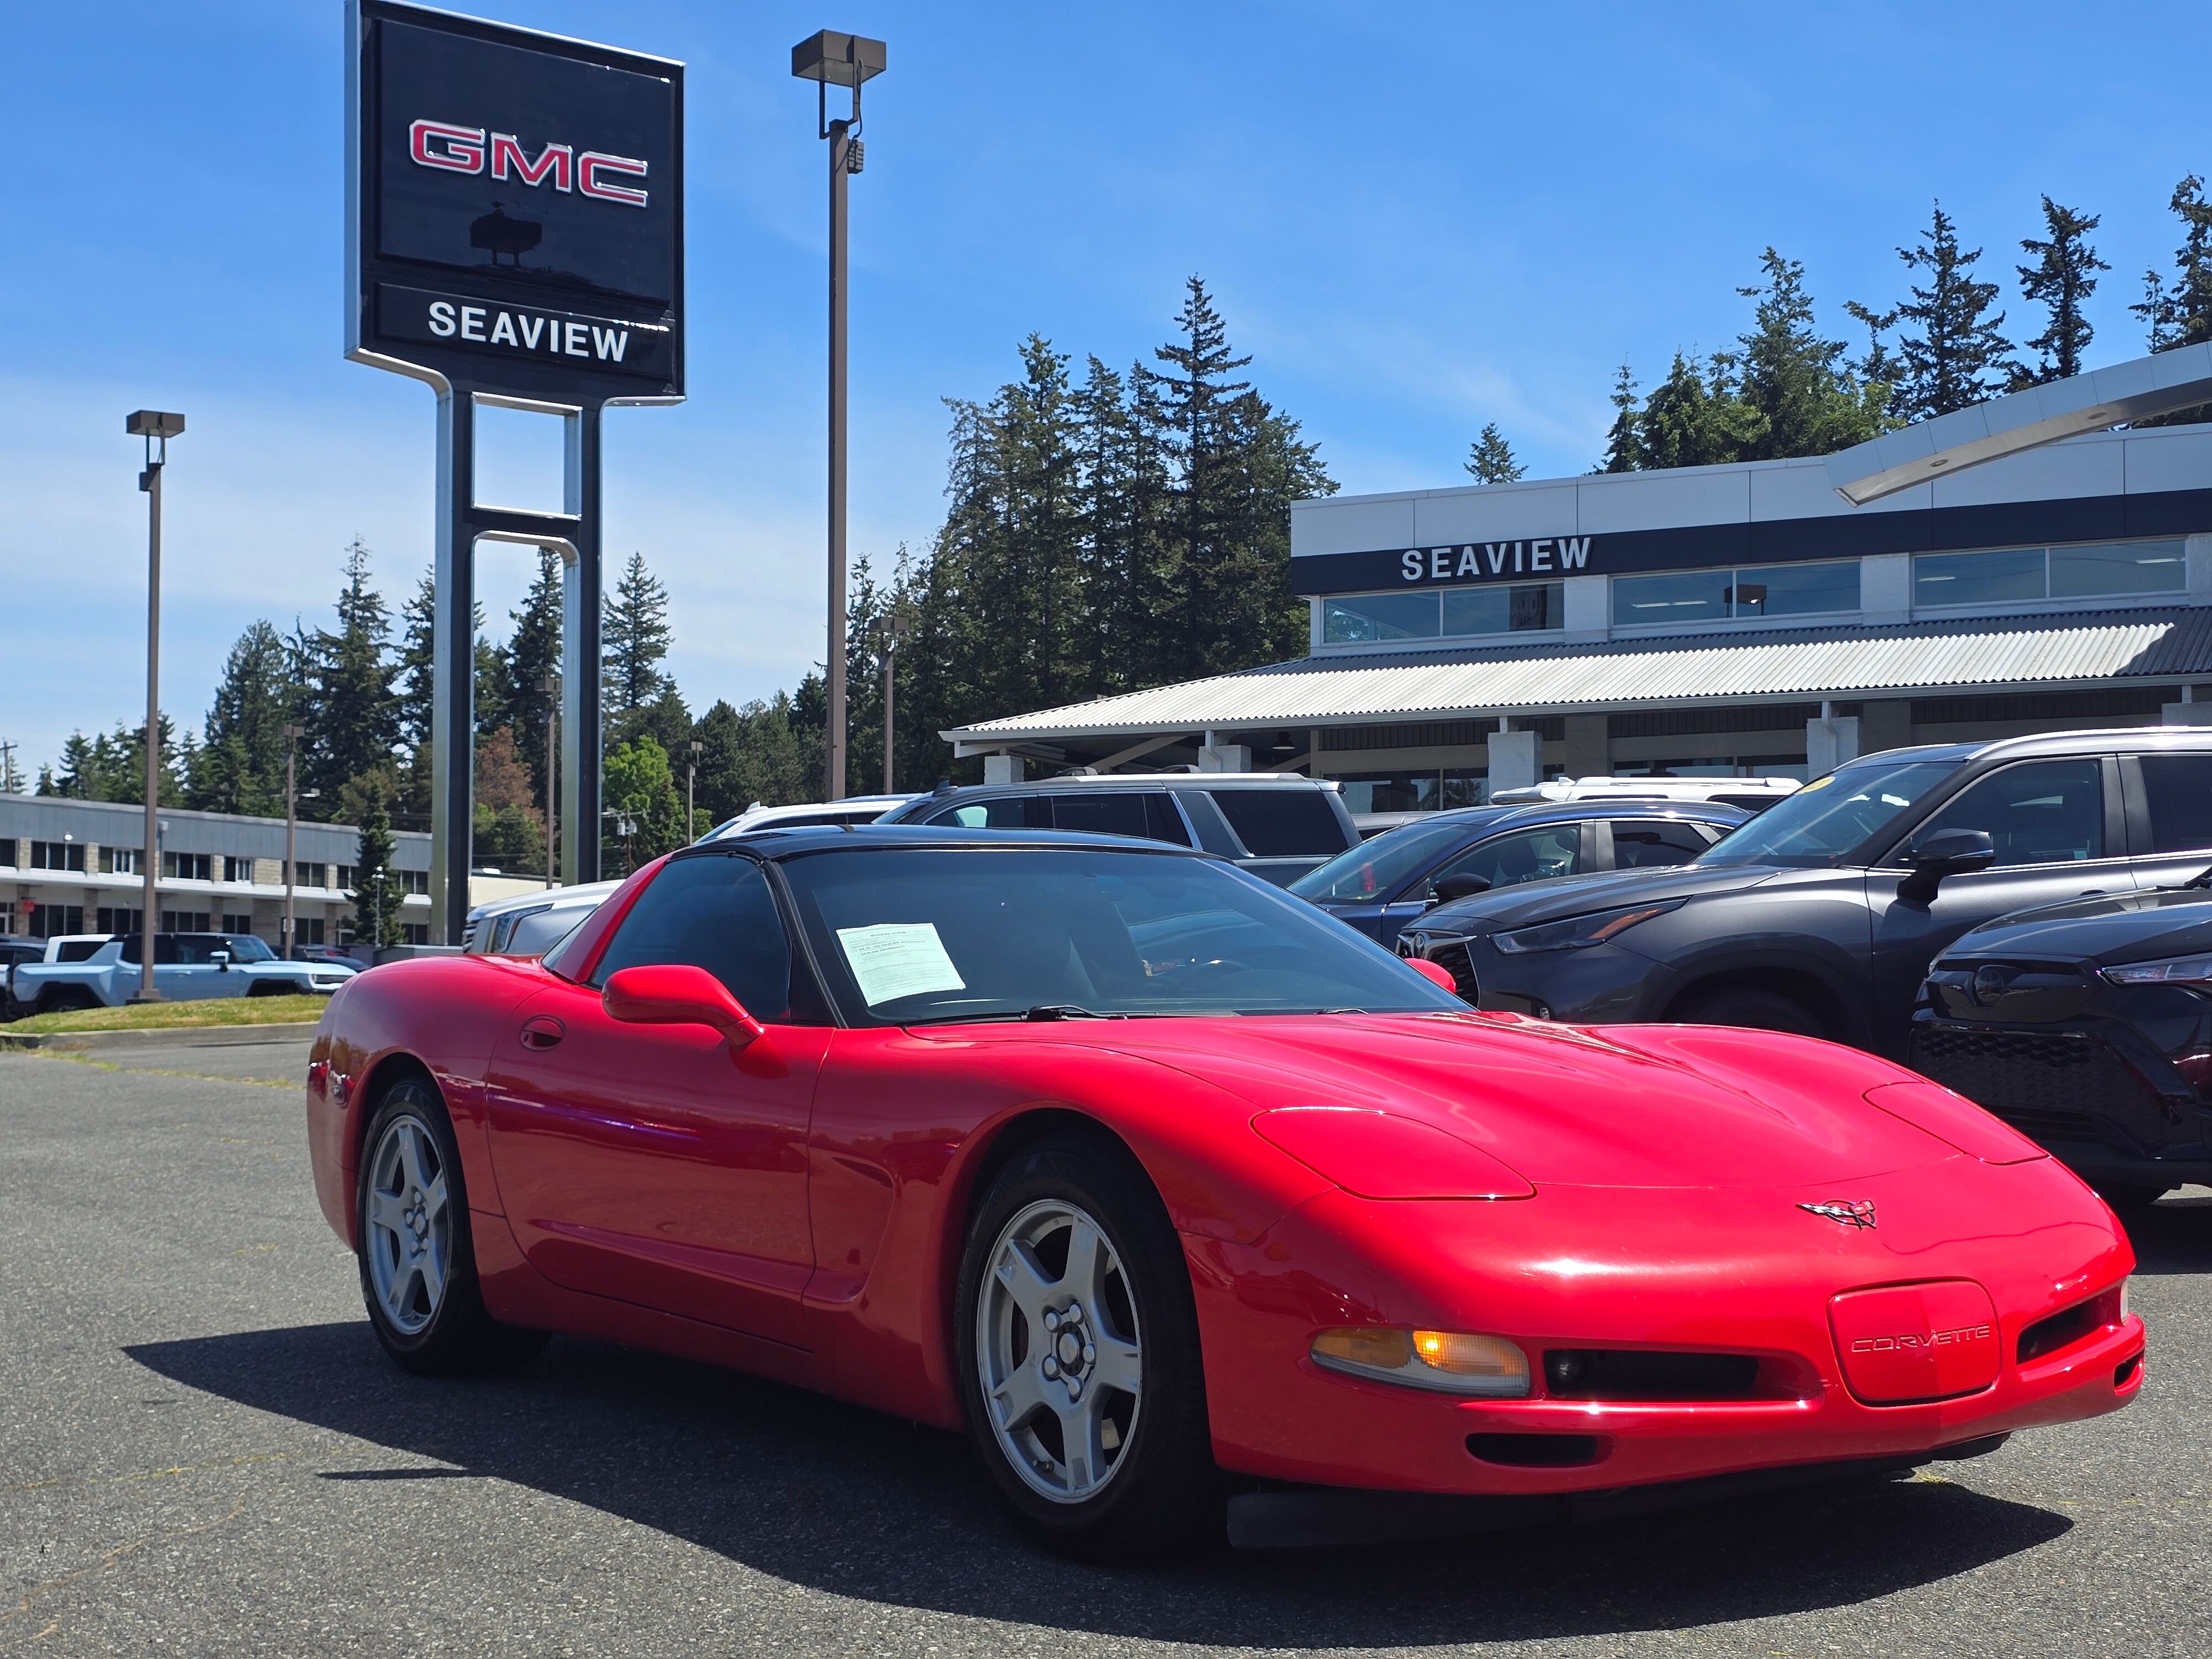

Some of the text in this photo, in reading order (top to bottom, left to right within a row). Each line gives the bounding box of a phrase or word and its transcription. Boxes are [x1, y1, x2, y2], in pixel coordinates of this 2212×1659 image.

[409, 118, 649, 208] GMC
[428, 301, 628, 362] SEAVIEW
[1401, 537, 1592, 581] SEAVIEW
[1851, 1323, 1990, 1352] CORVETTE
